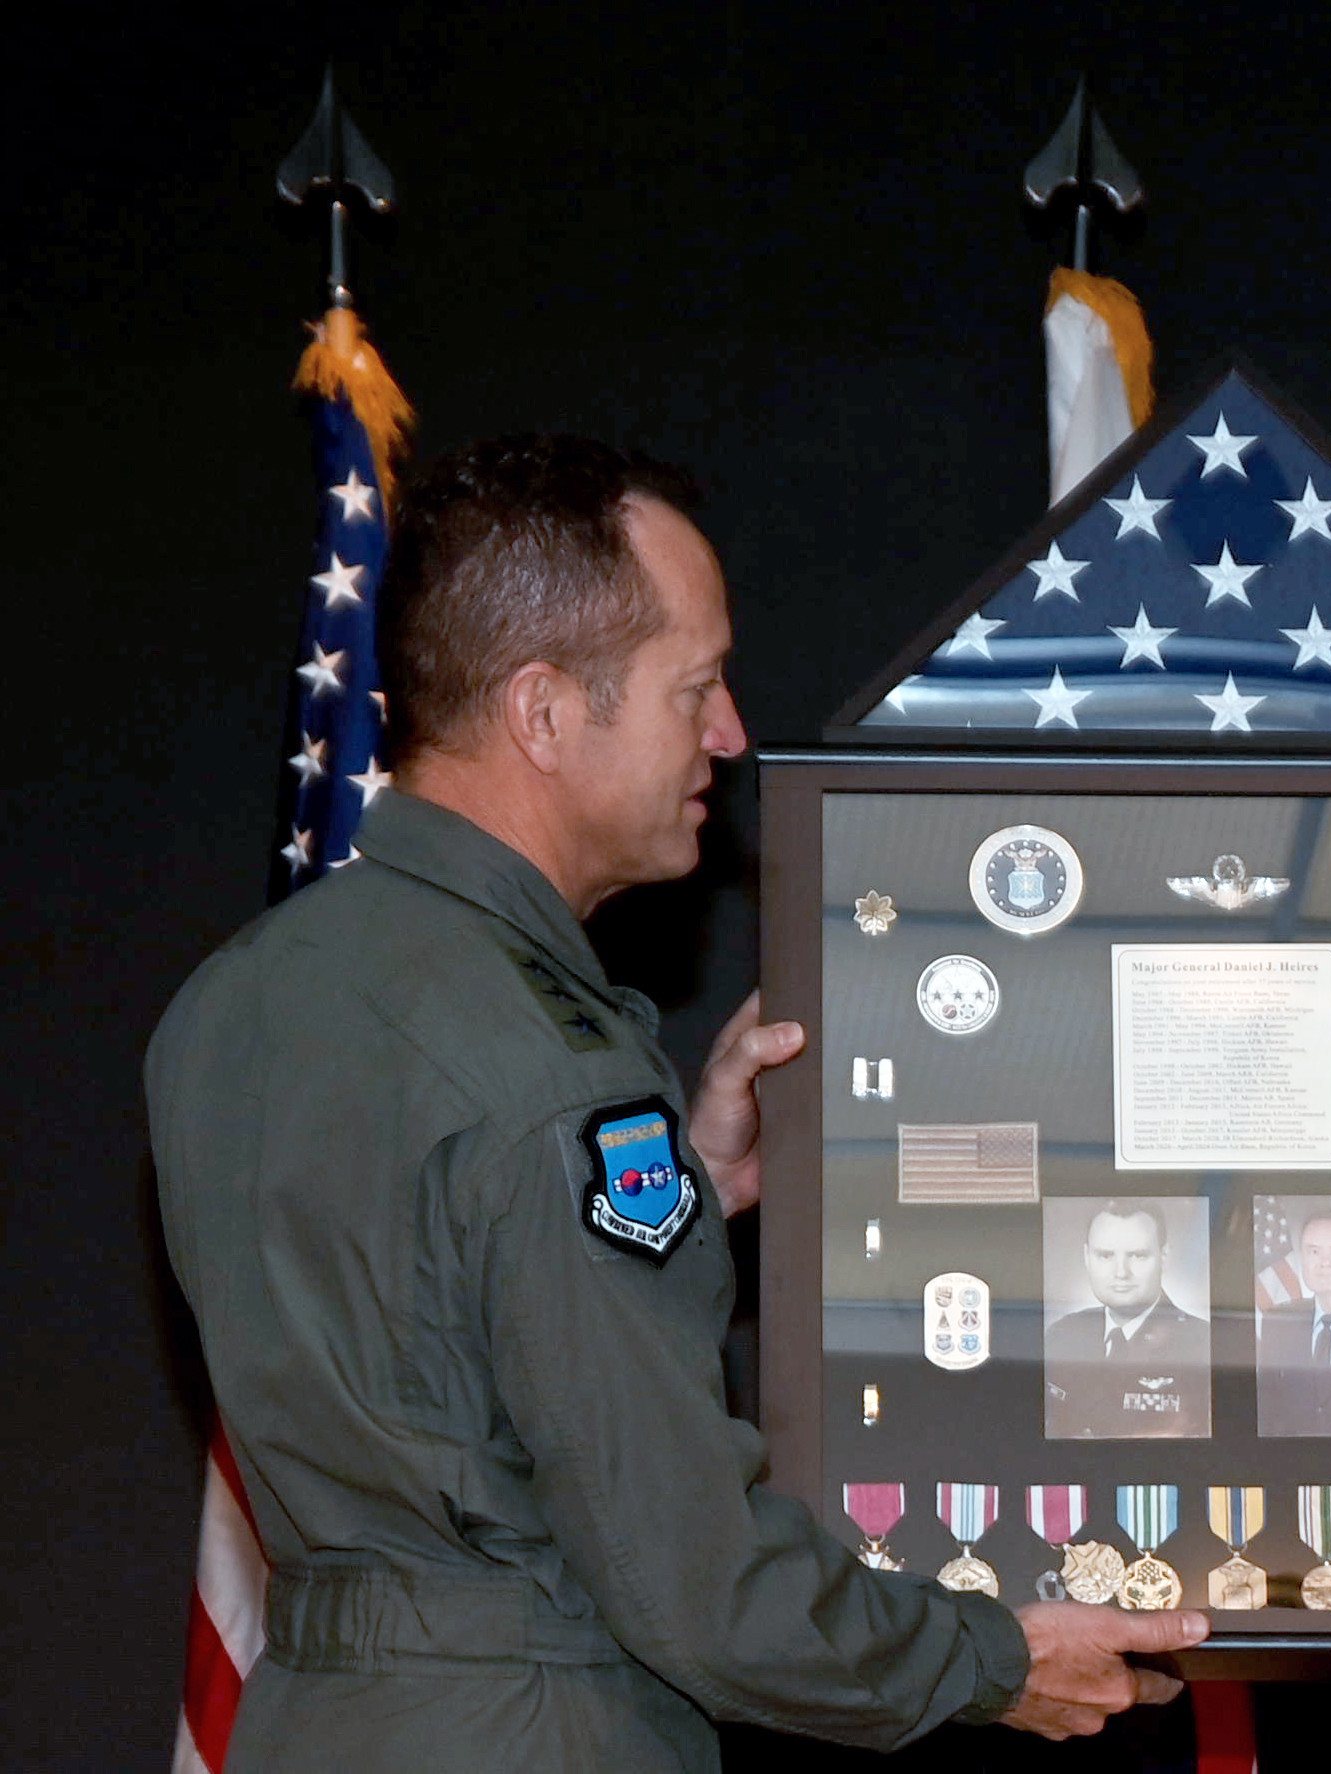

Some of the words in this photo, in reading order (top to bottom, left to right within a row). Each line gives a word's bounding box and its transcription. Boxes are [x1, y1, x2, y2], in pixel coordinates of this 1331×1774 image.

[1131, 961, 1169, 974] Major
[1172, 961, 1221, 972] General
[1224, 961, 1263, 972] Daniel
[1266, 961, 1277, 972] J.
[1280, 961, 1319, 972] Heires
